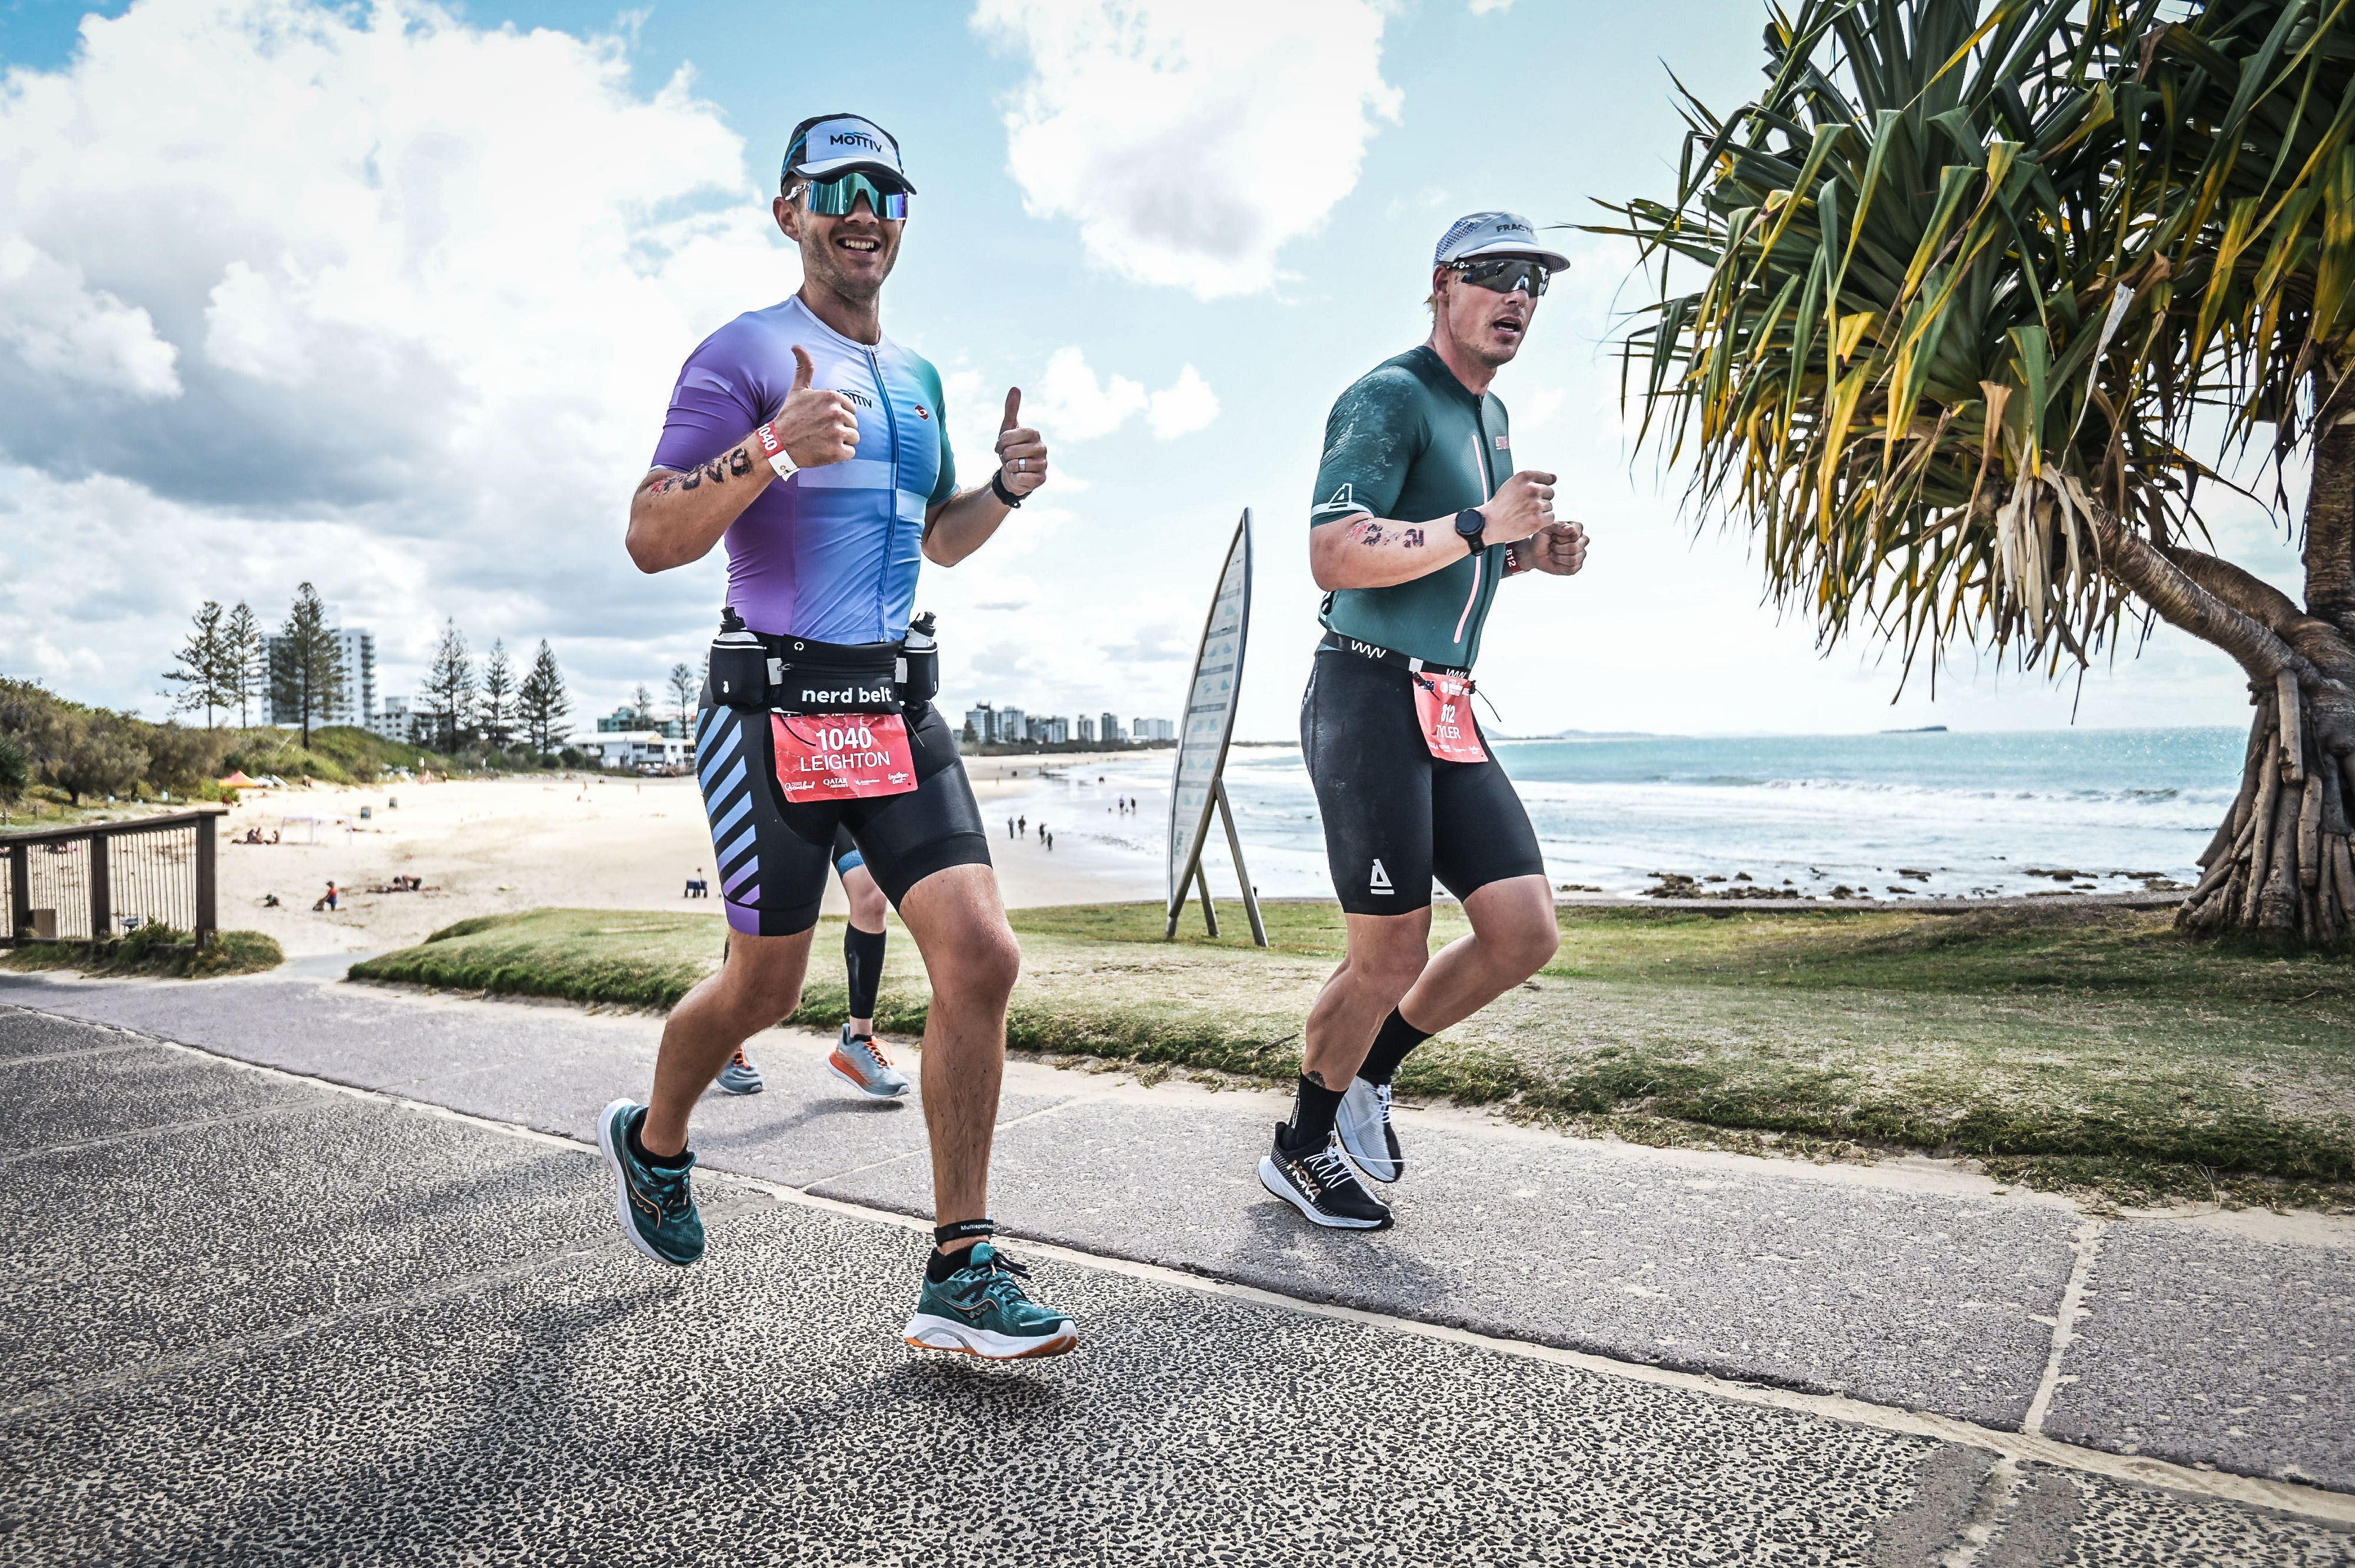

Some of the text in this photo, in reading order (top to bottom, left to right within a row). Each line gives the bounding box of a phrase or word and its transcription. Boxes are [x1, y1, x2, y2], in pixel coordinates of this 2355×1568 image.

[830, 134, 882, 153] MOTTIV
[757, 423, 778, 451] 1040
[1505, 549, 1517, 567] 812
[802, 686, 893, 703] nerd belt
[1441, 703, 1455, 724] 812
[815, 726, 872, 751] 1040
[1436, 725, 1462, 739] TYLER
[800, 750, 891, 772] LEIGHTON
[1286, 1160, 1322, 1202] HOKA
